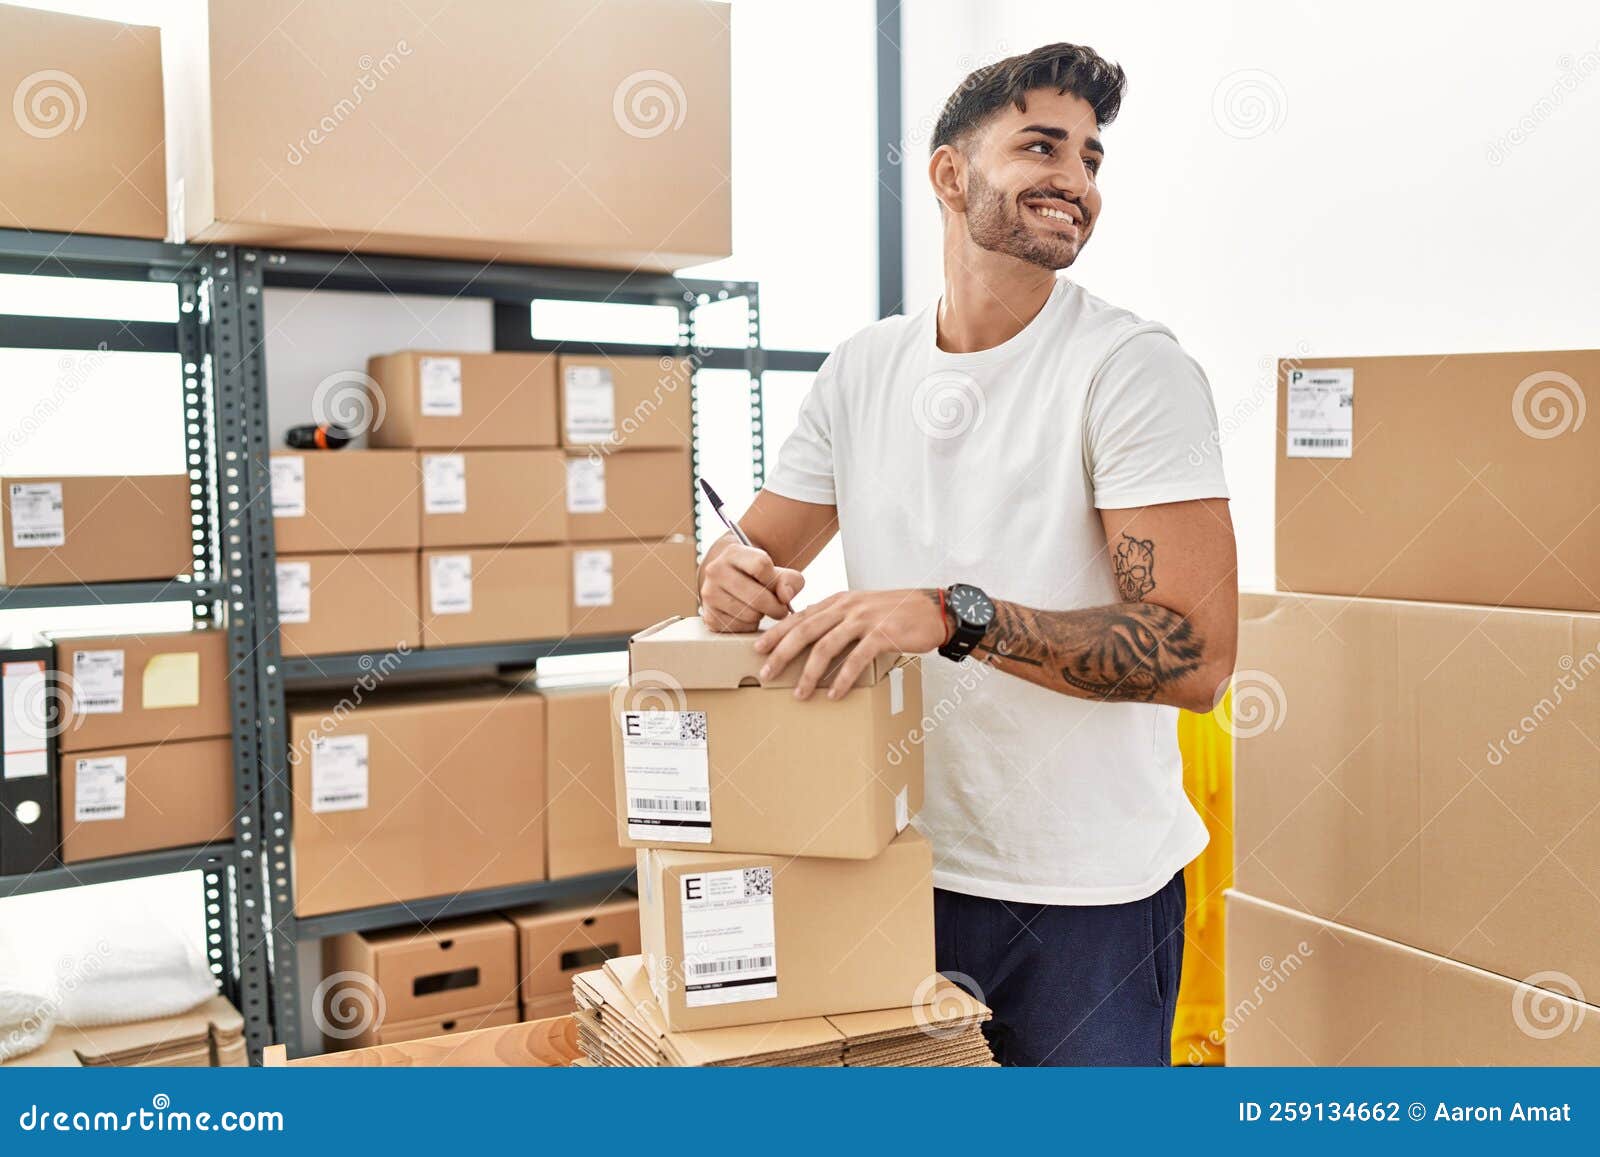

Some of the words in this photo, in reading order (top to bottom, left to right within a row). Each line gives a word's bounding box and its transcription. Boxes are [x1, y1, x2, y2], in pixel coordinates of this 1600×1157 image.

[1293, 372, 1303, 385] P
[626, 715, 641, 736] E
[686, 878, 702, 900] E
